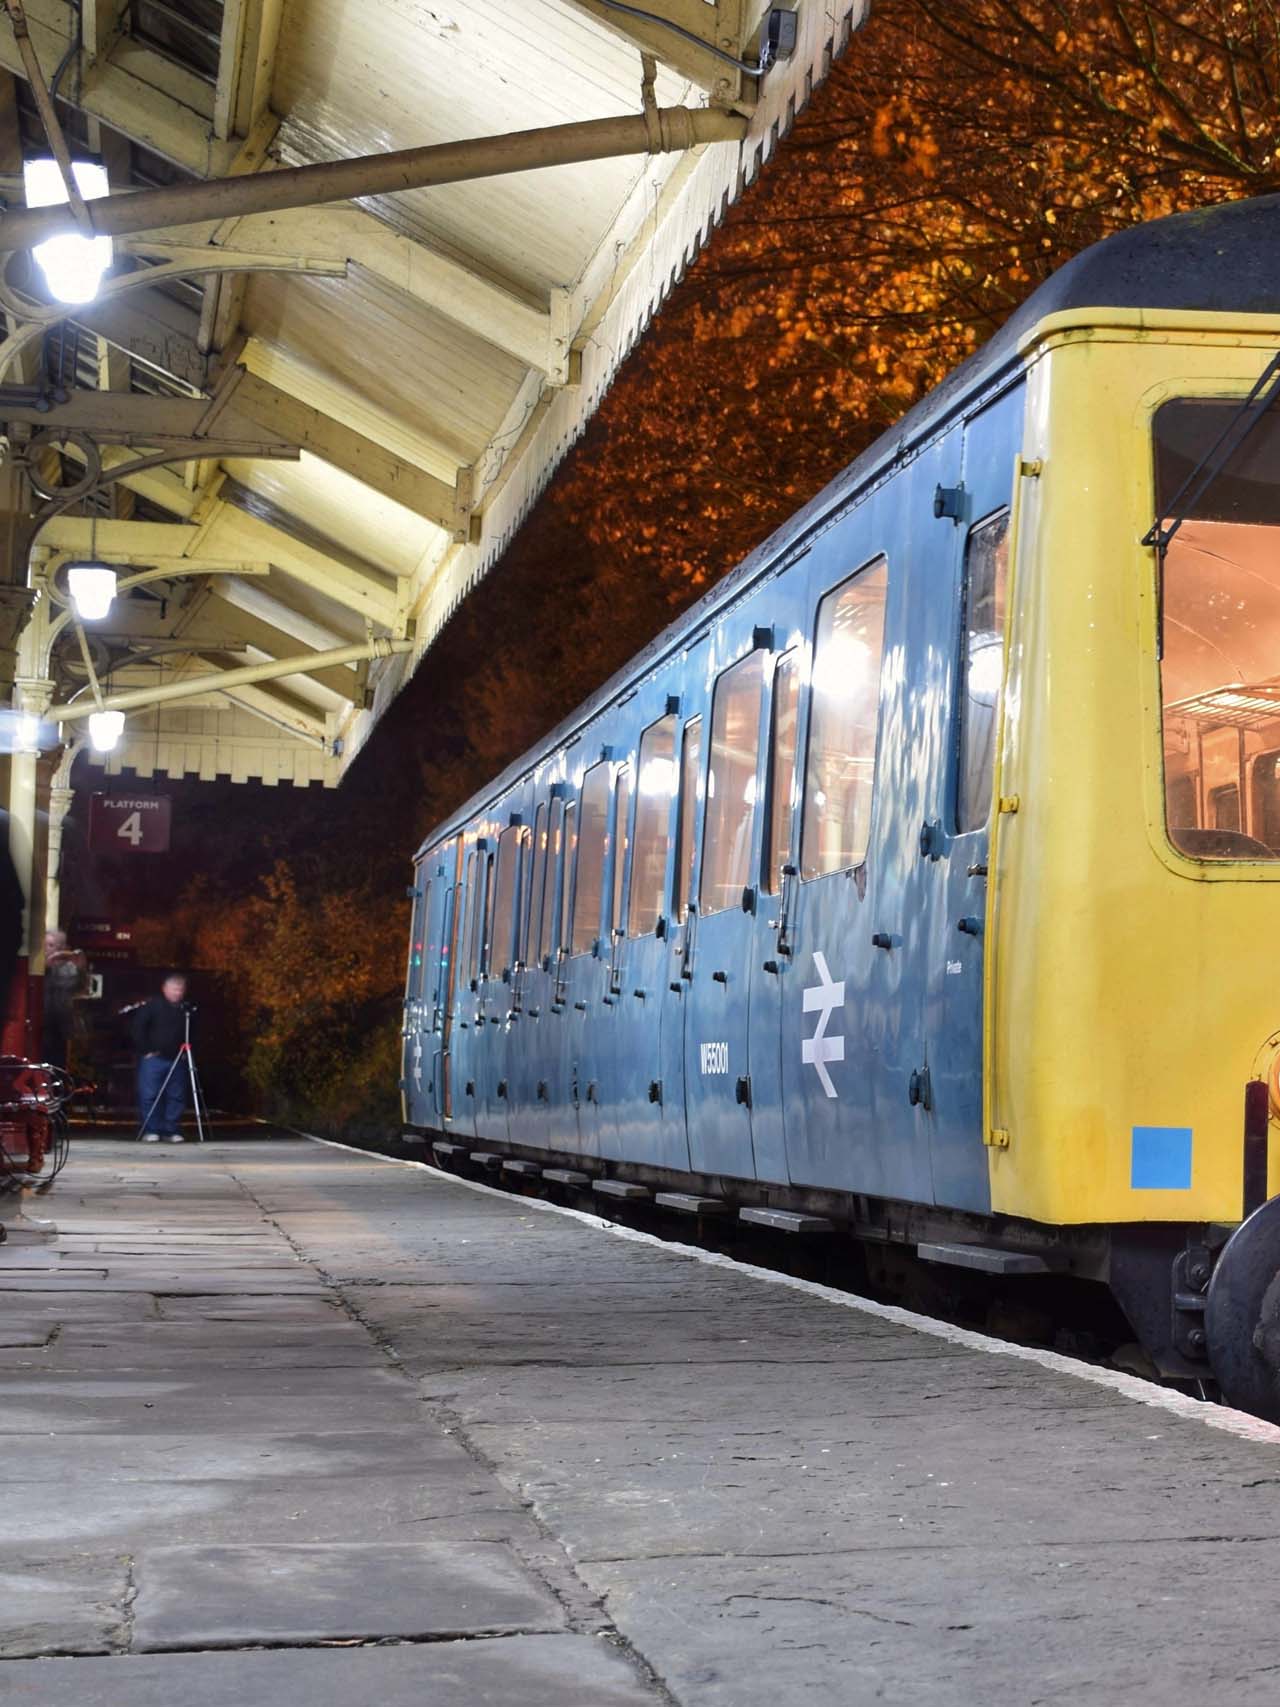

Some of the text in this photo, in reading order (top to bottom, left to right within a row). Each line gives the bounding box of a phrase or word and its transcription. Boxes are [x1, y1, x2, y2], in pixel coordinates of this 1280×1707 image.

[103, 800, 160, 809] PLATFORM
[117, 811, 143, 846] 4
[700, 1042, 729, 1074] W55001
